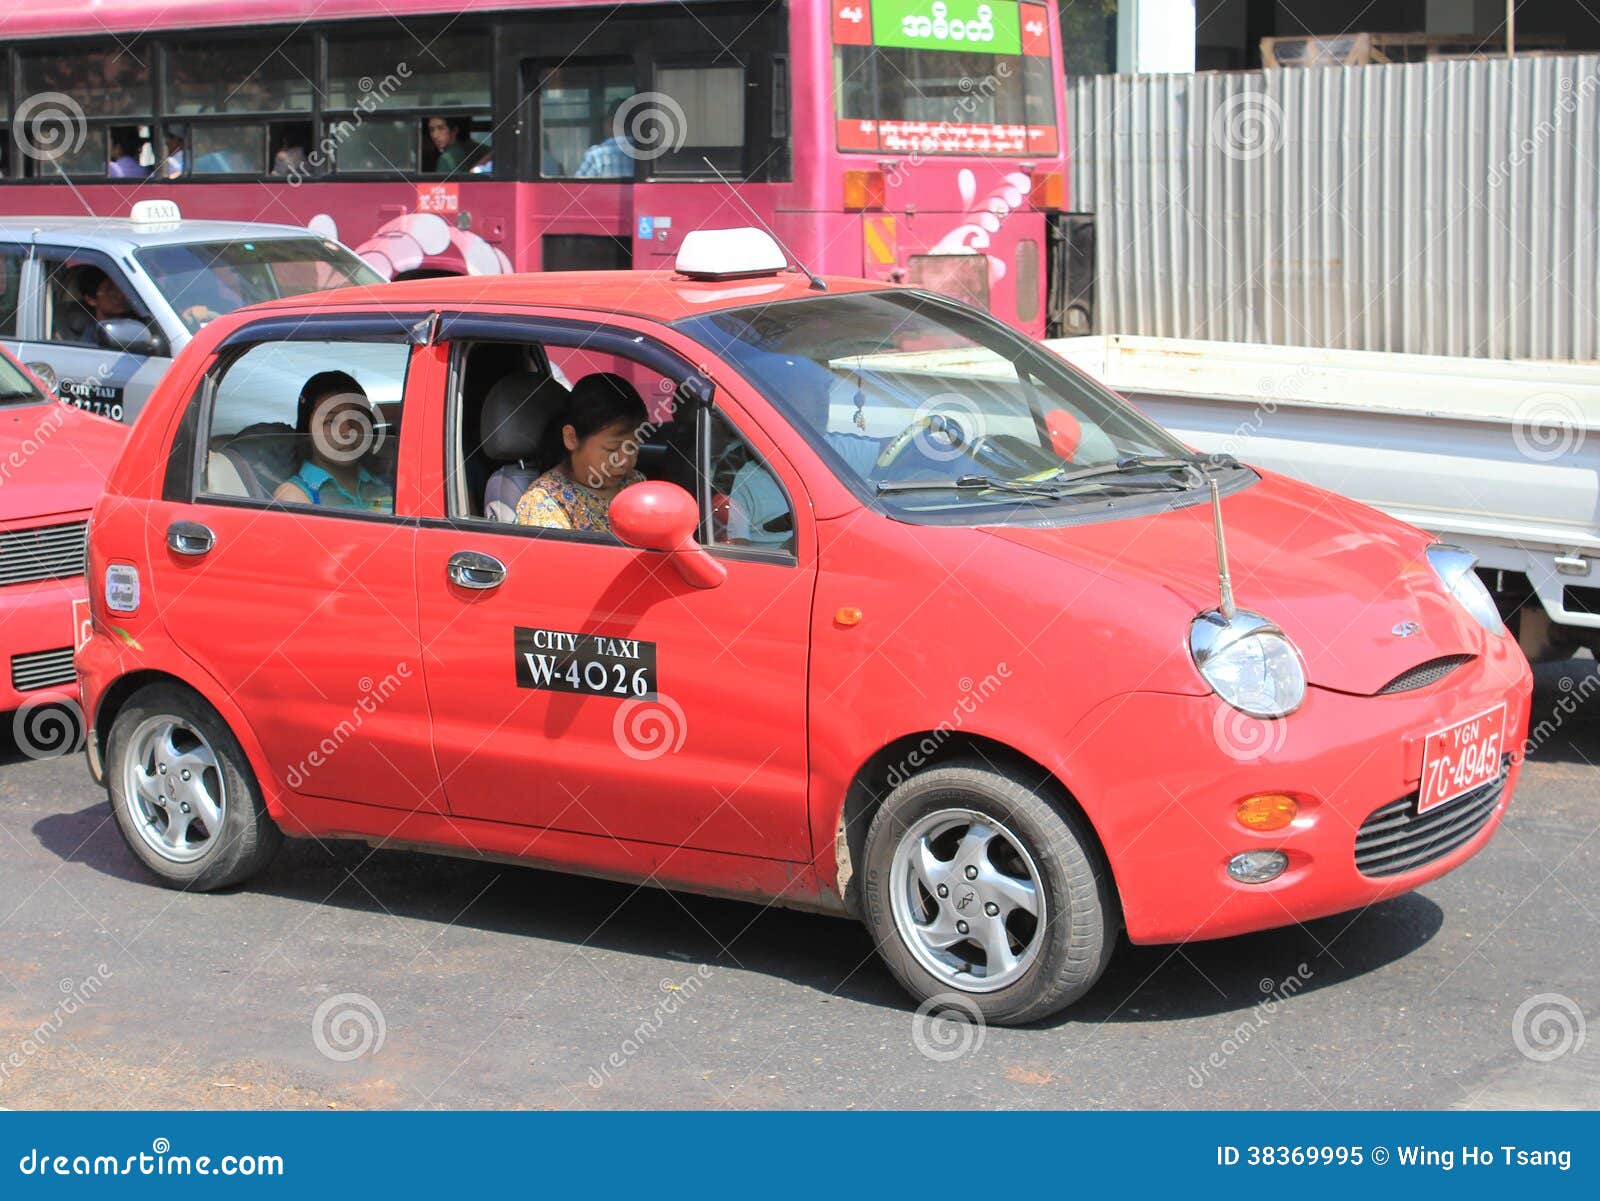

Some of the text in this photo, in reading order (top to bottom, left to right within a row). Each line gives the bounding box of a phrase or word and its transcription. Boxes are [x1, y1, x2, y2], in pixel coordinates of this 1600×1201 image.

[146, 206, 175, 218] TAXI
[533, 630, 640, 660] CITY TAXI
[523, 652, 648, 697] W-4026
[1453, 720, 1481, 749] YGN
[1424, 732, 1499, 805] 7C-4945
